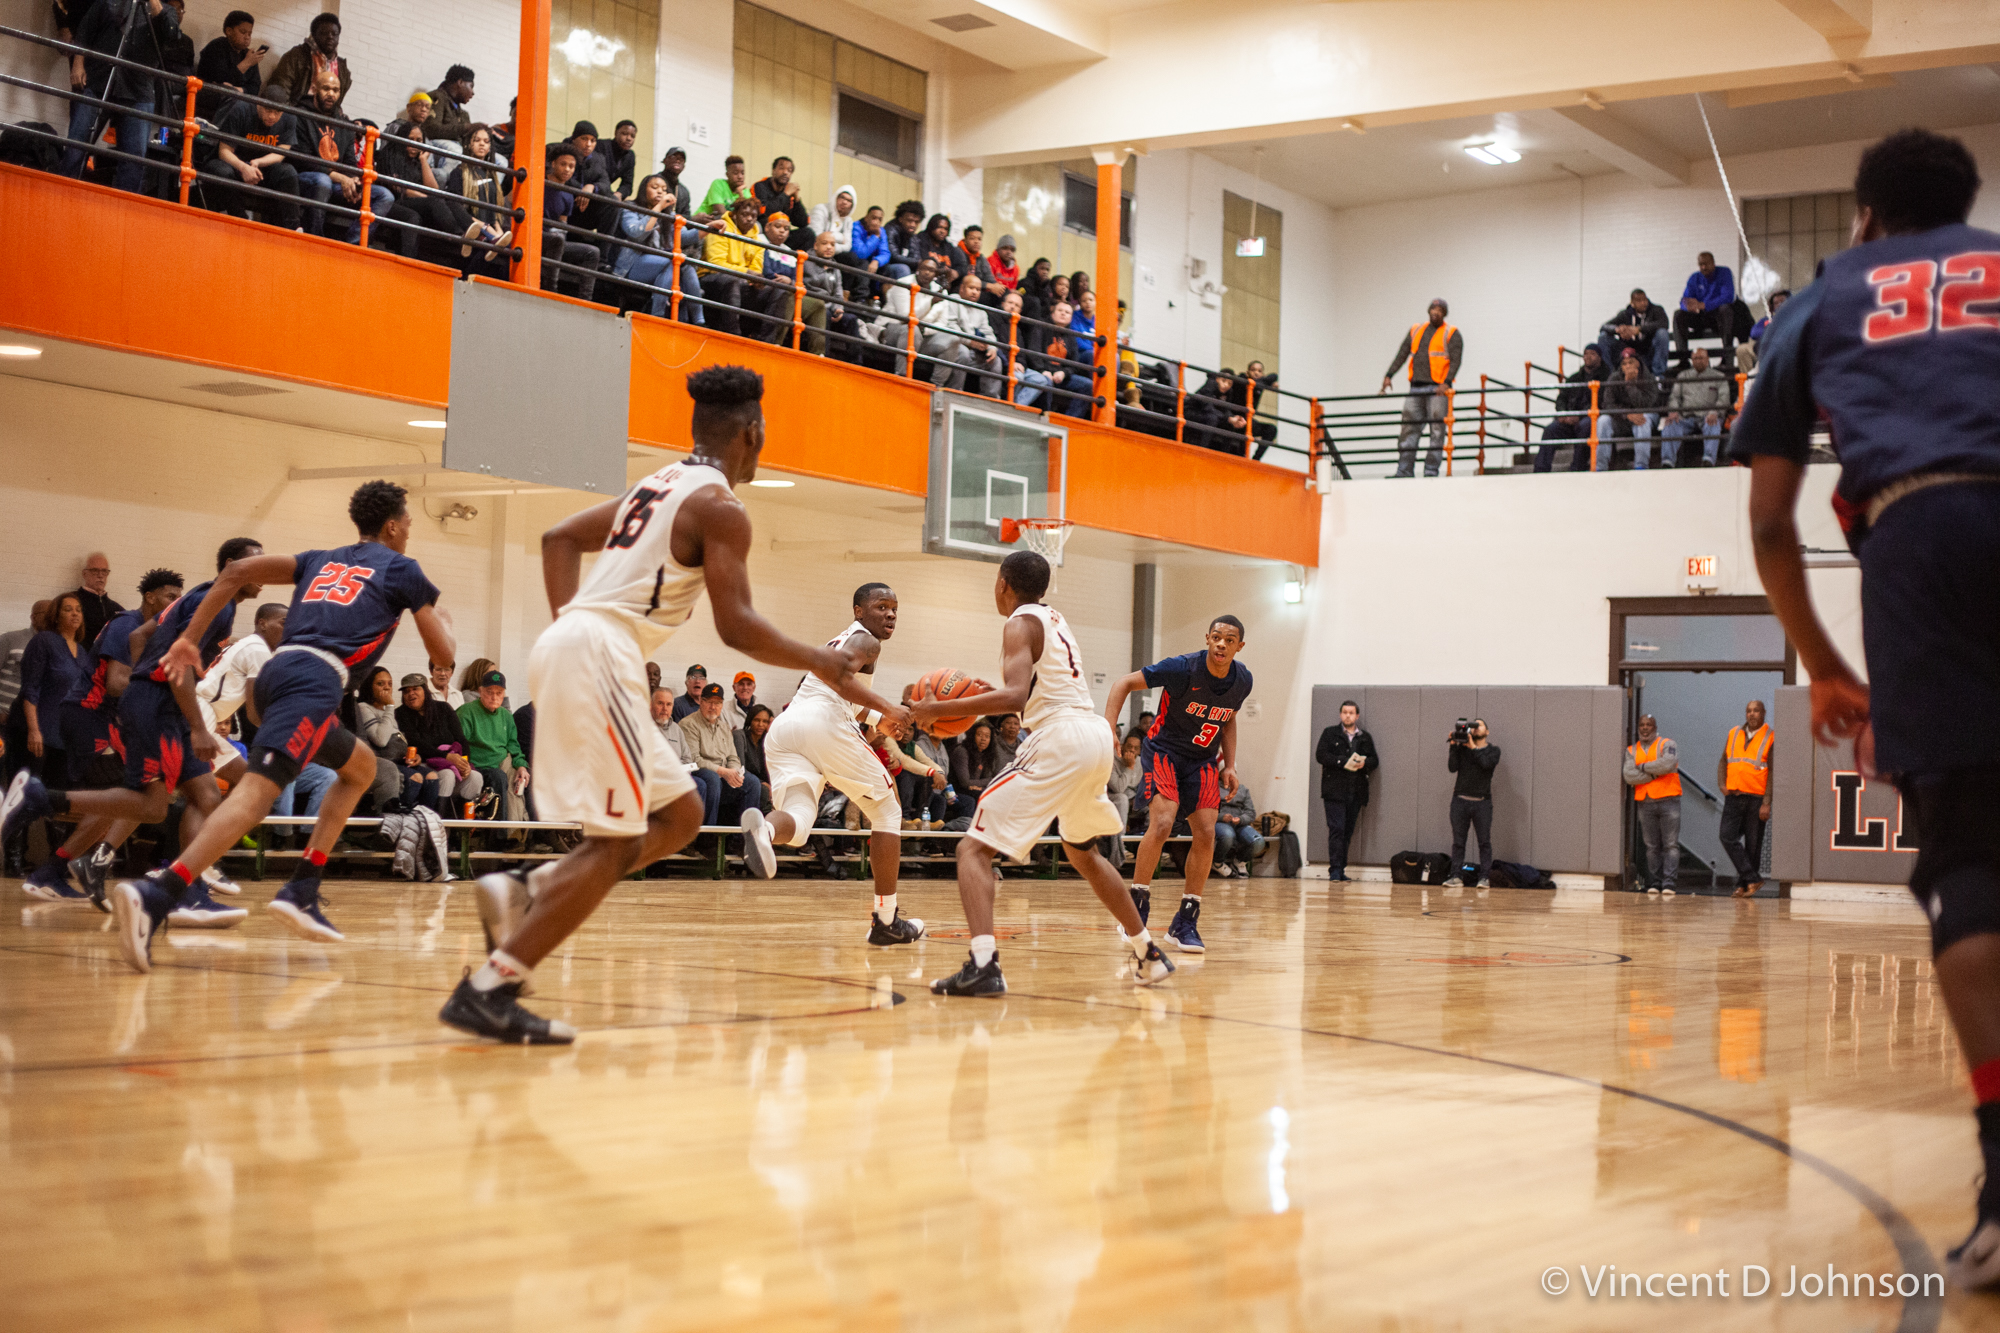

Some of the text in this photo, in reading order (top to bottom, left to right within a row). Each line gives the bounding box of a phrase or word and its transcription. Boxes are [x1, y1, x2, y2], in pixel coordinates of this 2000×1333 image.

[1865, 251, 2000, 341] 32
[1688, 557, 1712, 576] EXIT
[301, 562, 375, 606] 25
[1057, 631, 1079, 678] 1
[1185, 702, 1207, 718] ST.
[1208, 706, 1234, 721] RIT
[1192, 722, 1220, 748] 3
[605, 788, 625, 818] L
[975, 808, 985, 832] L
